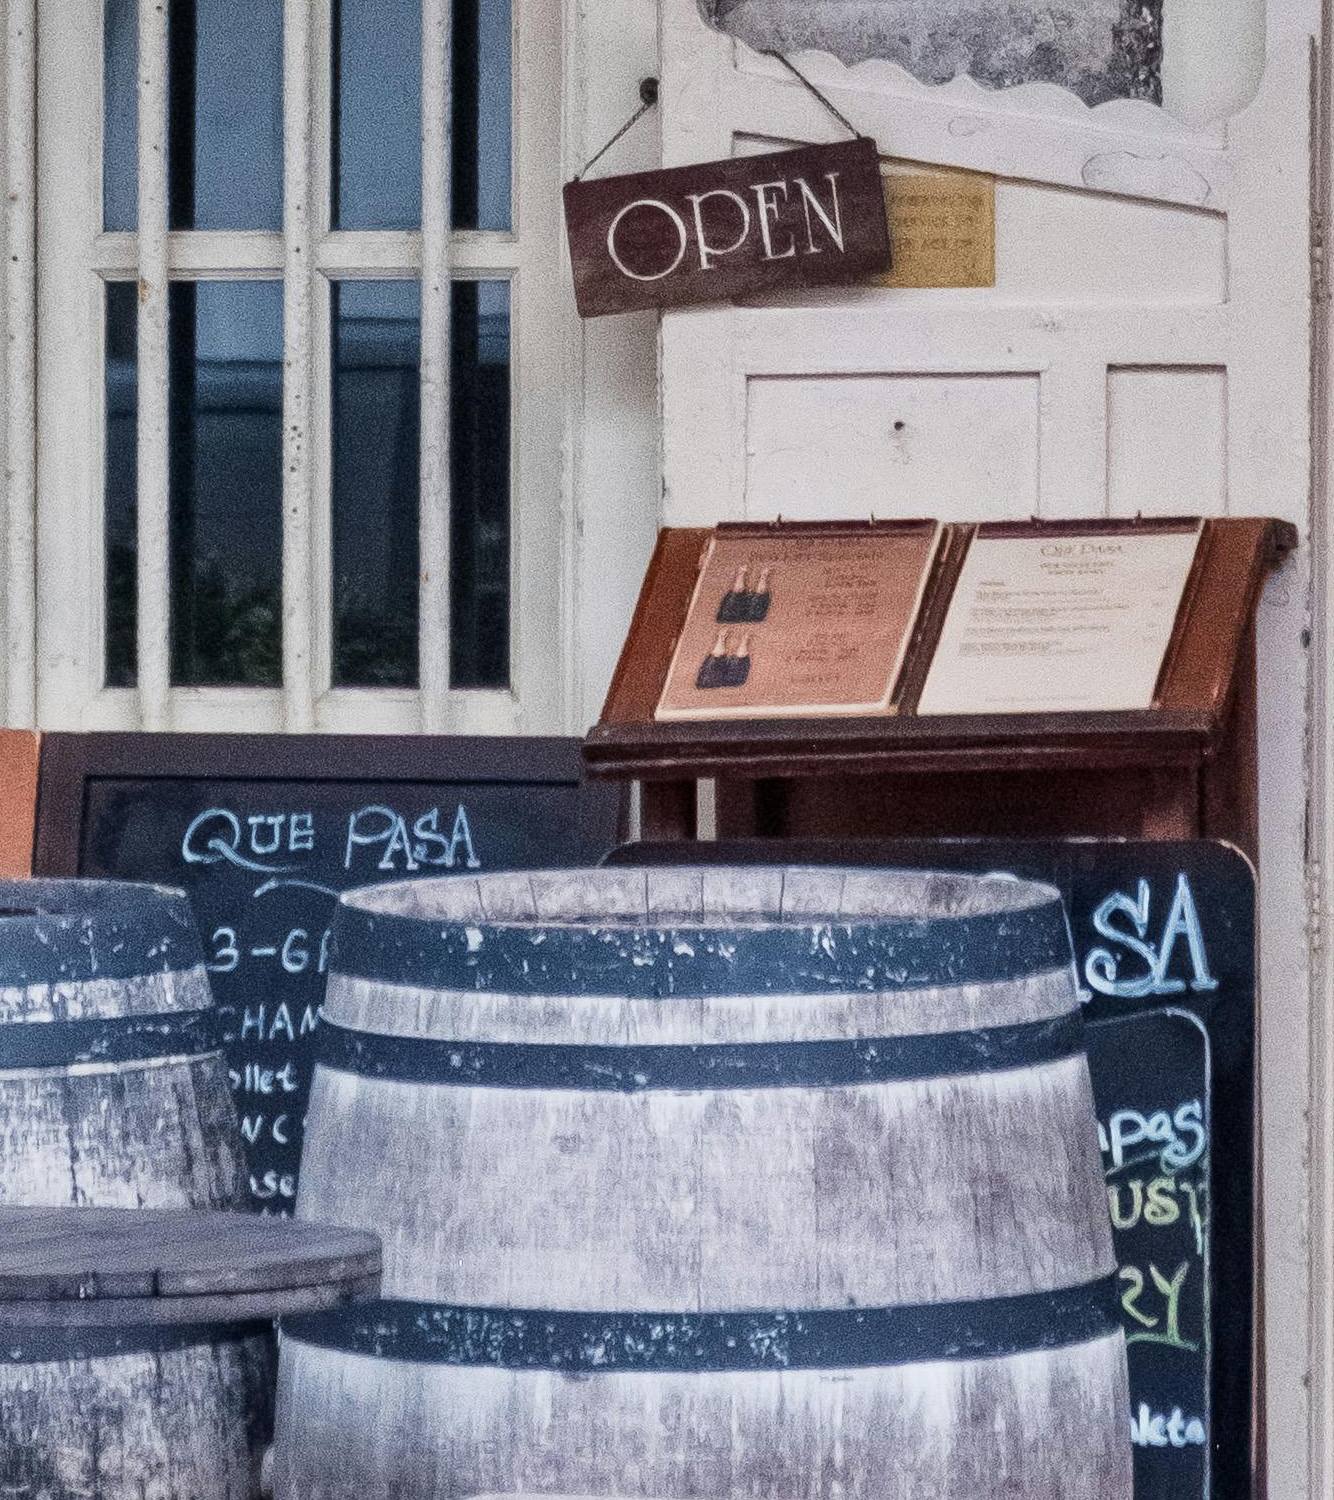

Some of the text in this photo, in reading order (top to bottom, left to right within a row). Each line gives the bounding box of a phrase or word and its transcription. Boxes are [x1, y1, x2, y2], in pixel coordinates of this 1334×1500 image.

[607, 172, 845, 281] OPEN
[182, 804, 481, 872] QUE PASA
[1074, 872, 1219, 1003] SA
